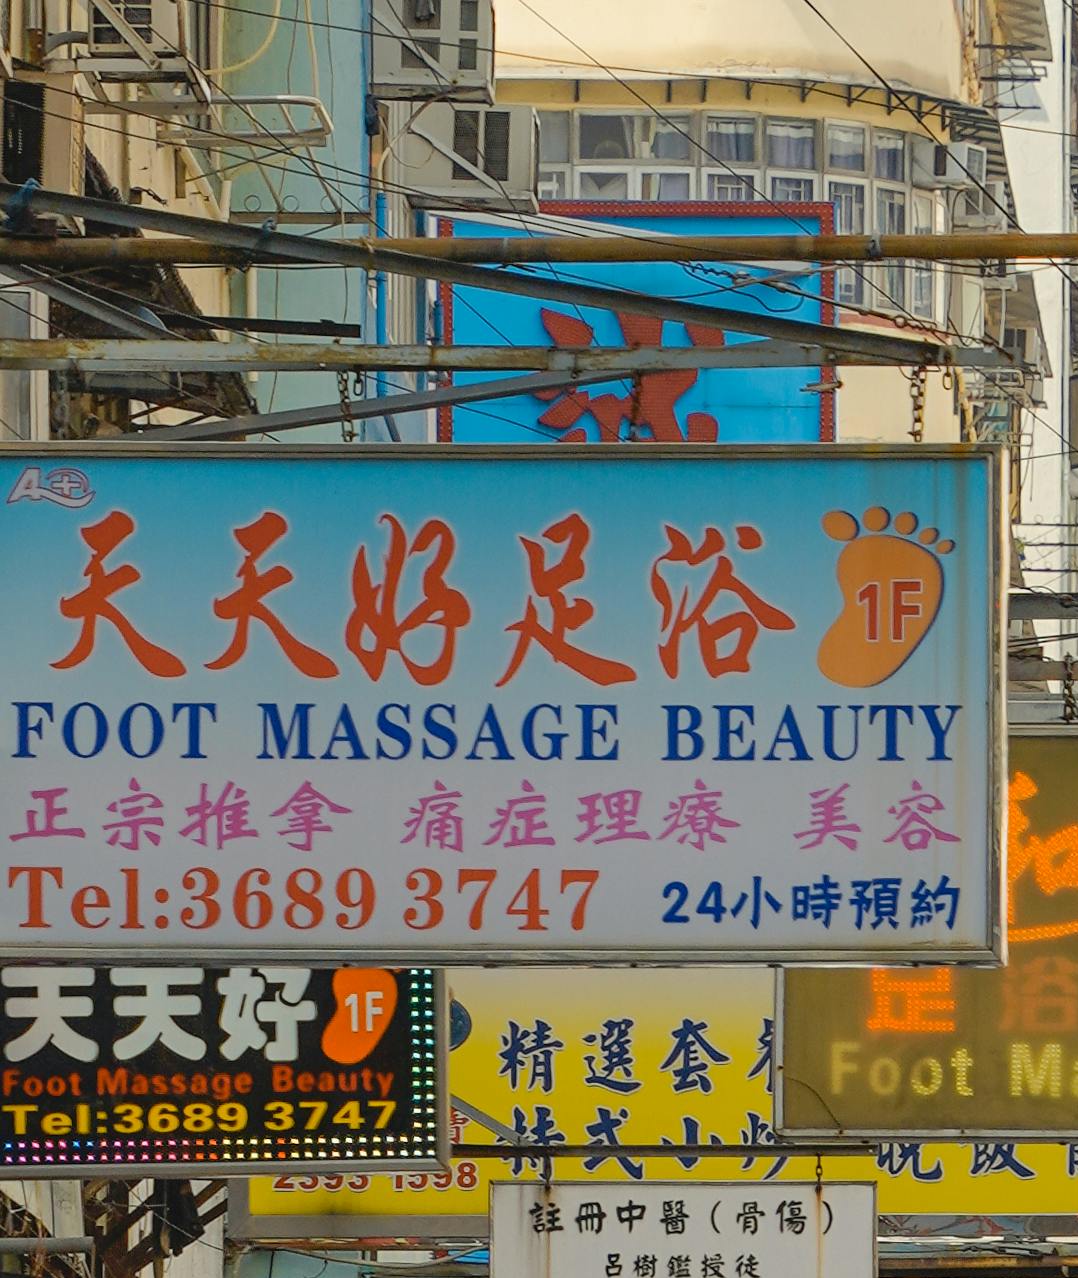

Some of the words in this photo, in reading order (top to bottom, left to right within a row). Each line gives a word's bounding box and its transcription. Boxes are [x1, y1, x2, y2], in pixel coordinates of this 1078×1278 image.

[50, 510, 796, 688] 天天好足浴
[856, 579, 925, 643] 1F
[10, 701, 218, 760] FOOT
[258, 702, 620, 762] MASSAGE
[662, 703, 961, 762] BEAUTY
[9, 779, 352, 852] 正宗推拿
[402, 779, 740, 854] 痛症理療
[794, 780, 960, 853] 美容
[8, 866, 376, 931] Tel:3689
[403, 868, 600, 932] 3747
[662, 876, 960, 930] 24小時預約
[2, 969, 317, 1063] 天天好
[344, 992, 384, 1032] 1F
[3, 1068, 82, 1098] Foot
[96, 1068, 254, 1099] Massage
[272, 1067, 395, 1100] Beauty
[829, 1042, 975, 1097] Foot
[3, 1102, 248, 1136] Tel:3689
[264, 1101, 397, 1132] 3747
